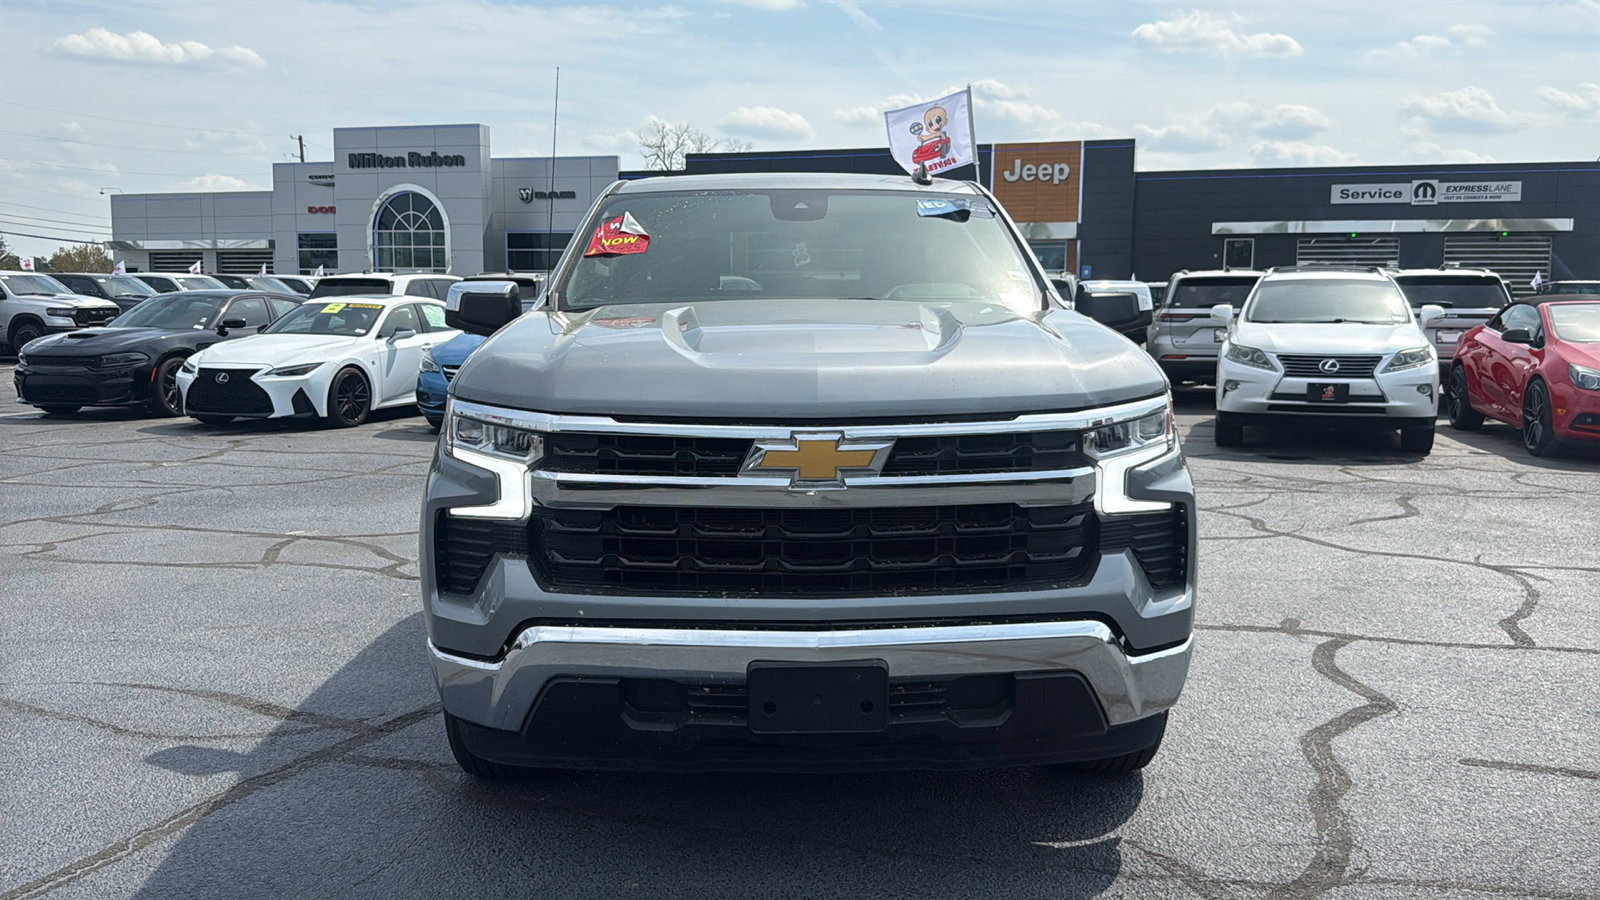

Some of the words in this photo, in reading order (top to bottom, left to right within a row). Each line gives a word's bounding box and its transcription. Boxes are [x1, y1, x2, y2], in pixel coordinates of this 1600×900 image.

[348, 152, 406, 169] Milton
[407, 151, 465, 168] Ruben
[1003, 159, 1070, 185] Jeep
[1339, 188, 1403, 200] Service
[601, 236, 639, 246] NOW
